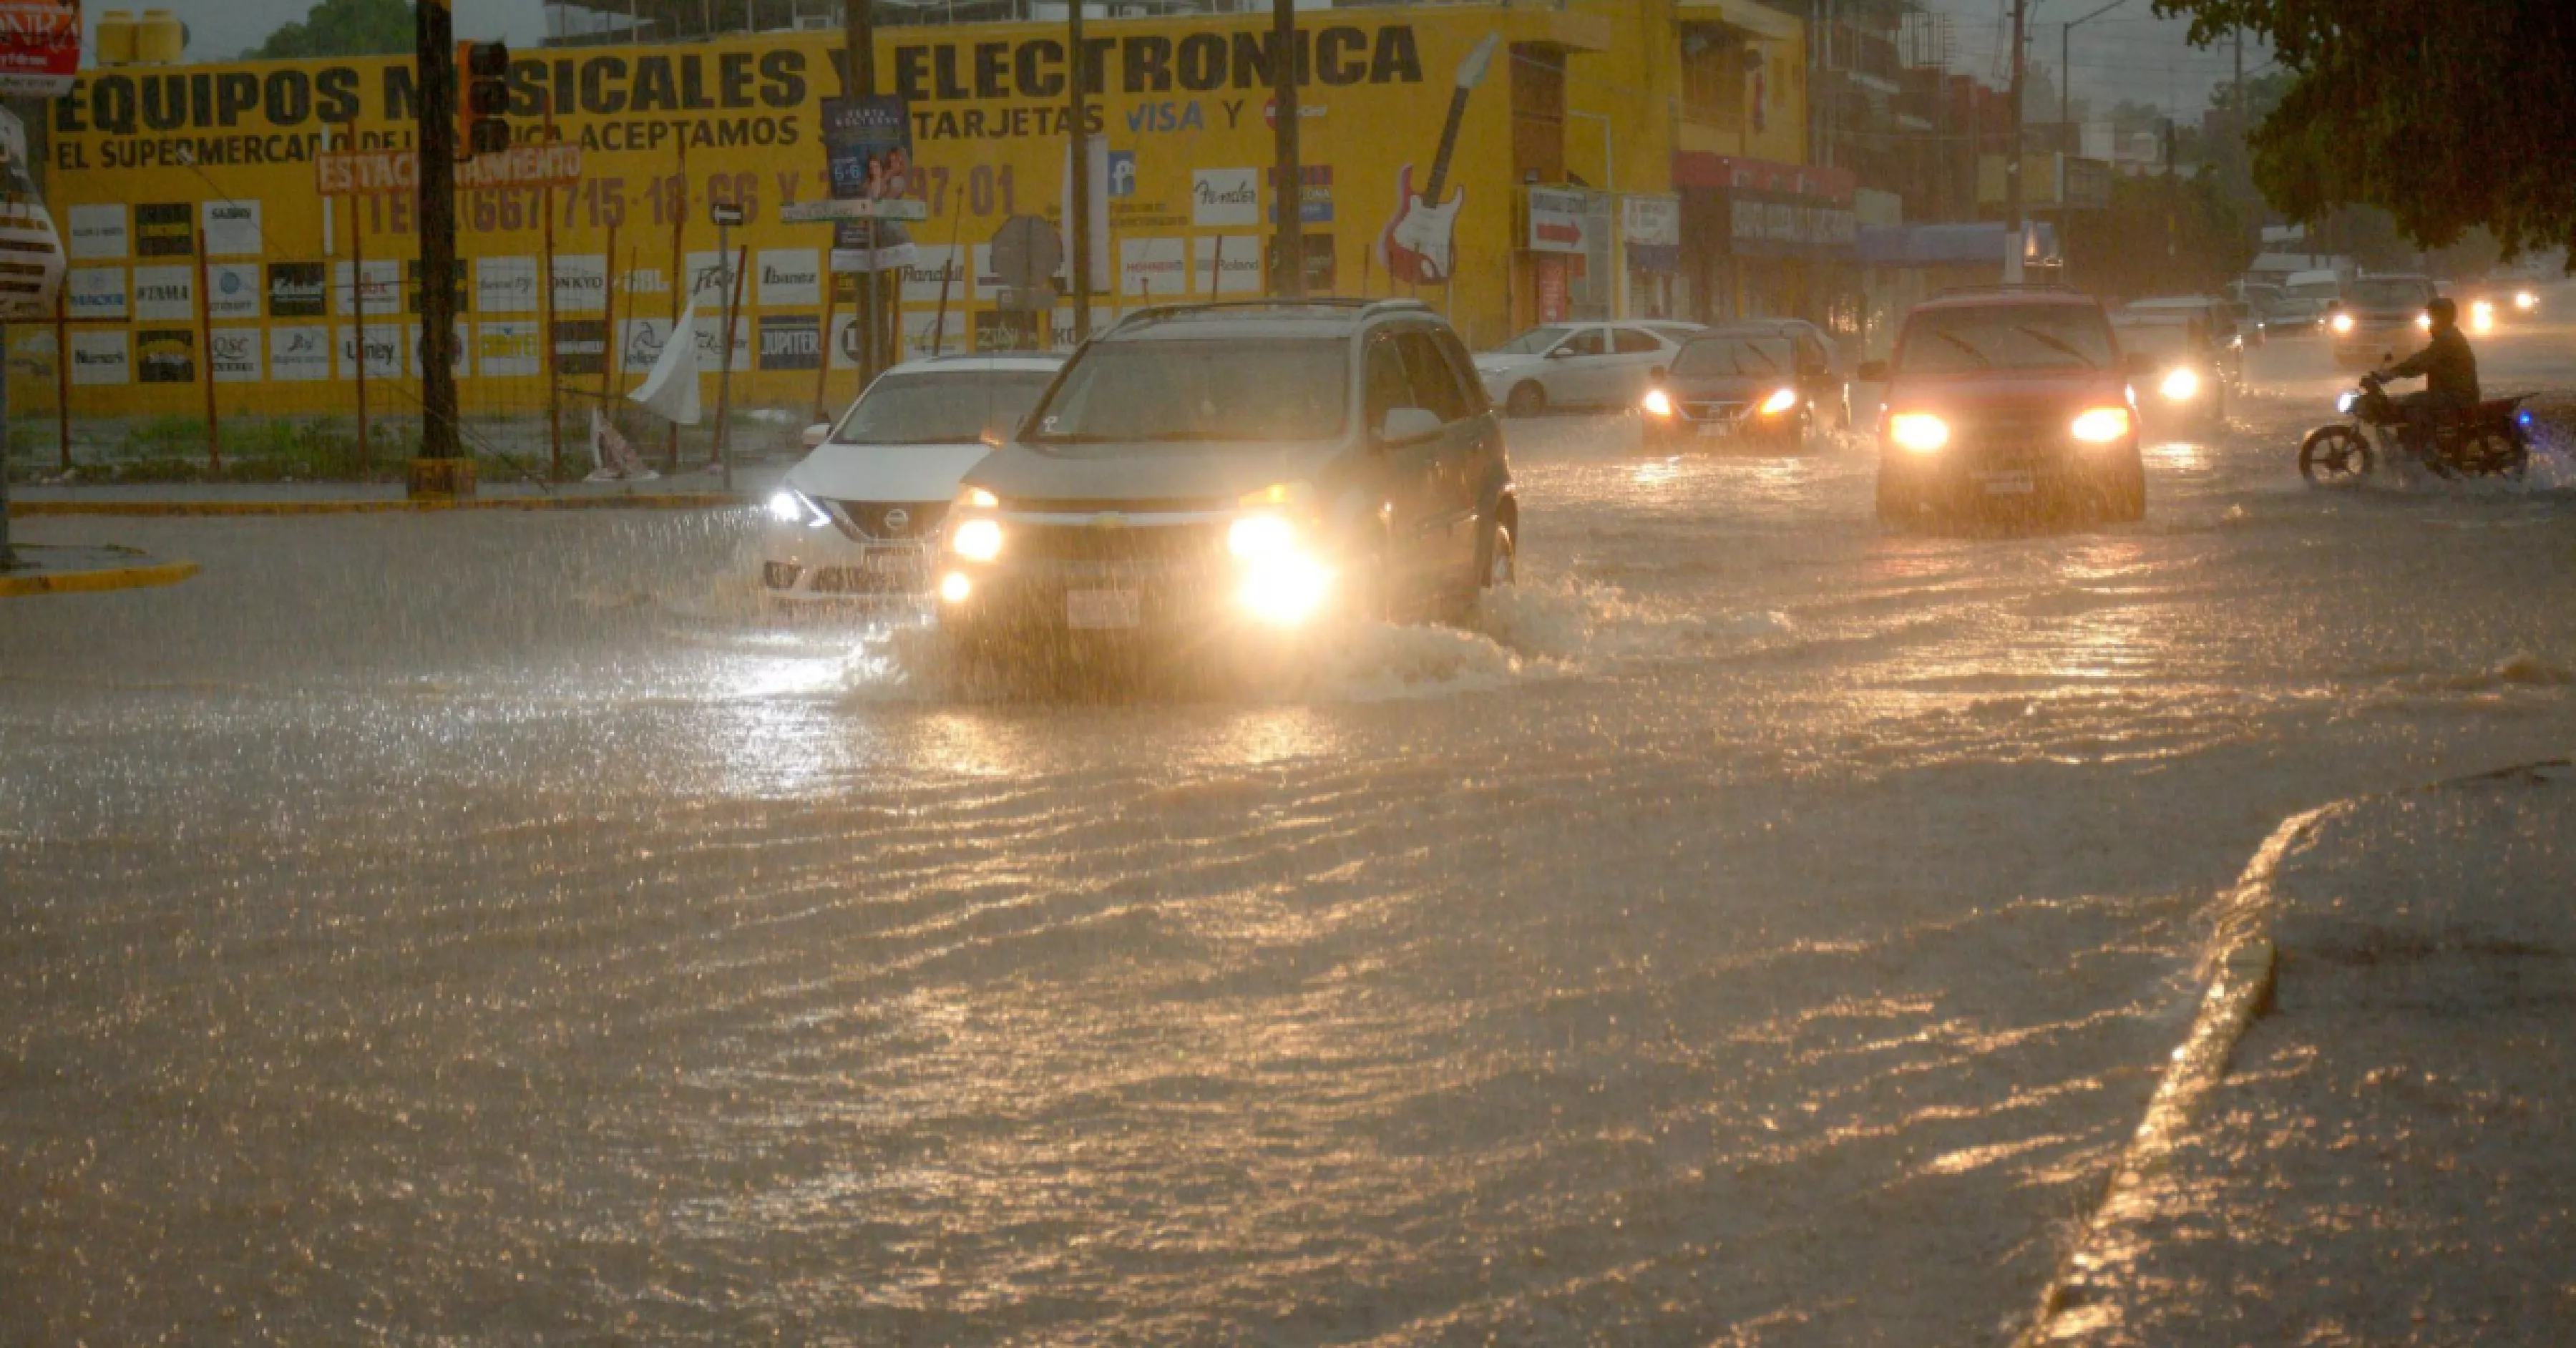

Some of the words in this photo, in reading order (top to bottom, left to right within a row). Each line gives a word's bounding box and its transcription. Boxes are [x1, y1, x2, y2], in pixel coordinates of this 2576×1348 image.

[56, 67, 358, 135] EQUIPOS
[384, 49, 806, 120] MSICALES
[897, 25, 1423, 101] ELECTRONICA
[57, 142, 90, 170] EL
[100, 132, 348, 168] SUPERMERCADO
[581, 115, 800, 151] ACEPTAMOS
[914, 104, 1103, 140] TARJETAS
[1127, 100, 1204, 132] VISA
[1223, 99, 1244, 130] Y
[778, 171, 799, 205] Y
[1194, 180, 1256, 205] Fender
[762, 265, 817, 285] Ibanez
[902, 265, 965, 282] Randll
[1219, 258, 1258, 270] Roland
[346, 341, 395, 366] Lney
[762, 330, 821, 356] JUPITER
